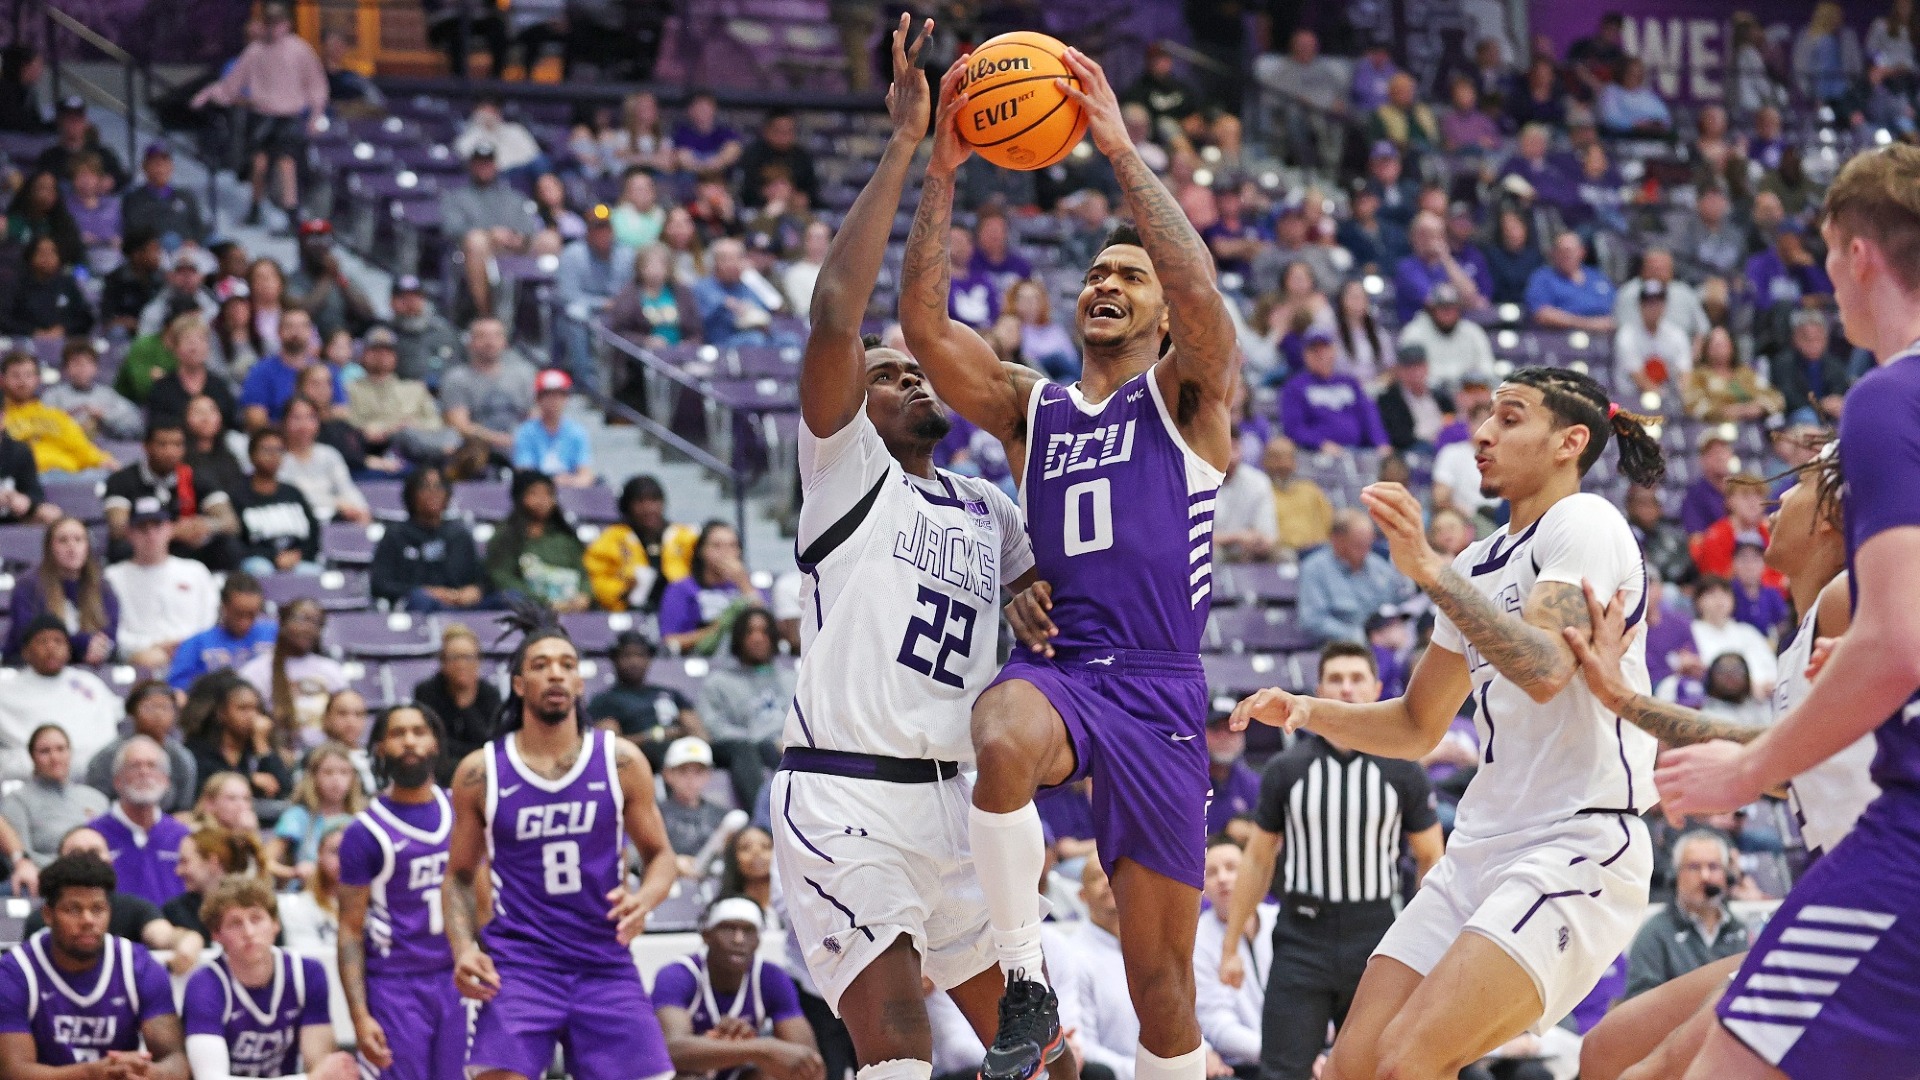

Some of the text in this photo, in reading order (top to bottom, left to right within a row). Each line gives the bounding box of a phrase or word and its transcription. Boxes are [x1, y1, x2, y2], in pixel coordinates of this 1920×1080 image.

[1126, 388, 1145, 404] WAC
[1043, 418, 1137, 481] GCU
[1063, 477, 1114, 557] 0
[893, 511, 996, 604] JACKS
[896, 583, 978, 690] 22
[516, 800, 598, 841] GCU
[408, 851, 450, 890] GC
[542, 840, 582, 895] 8
[53, 1015, 118, 1045] GCU
